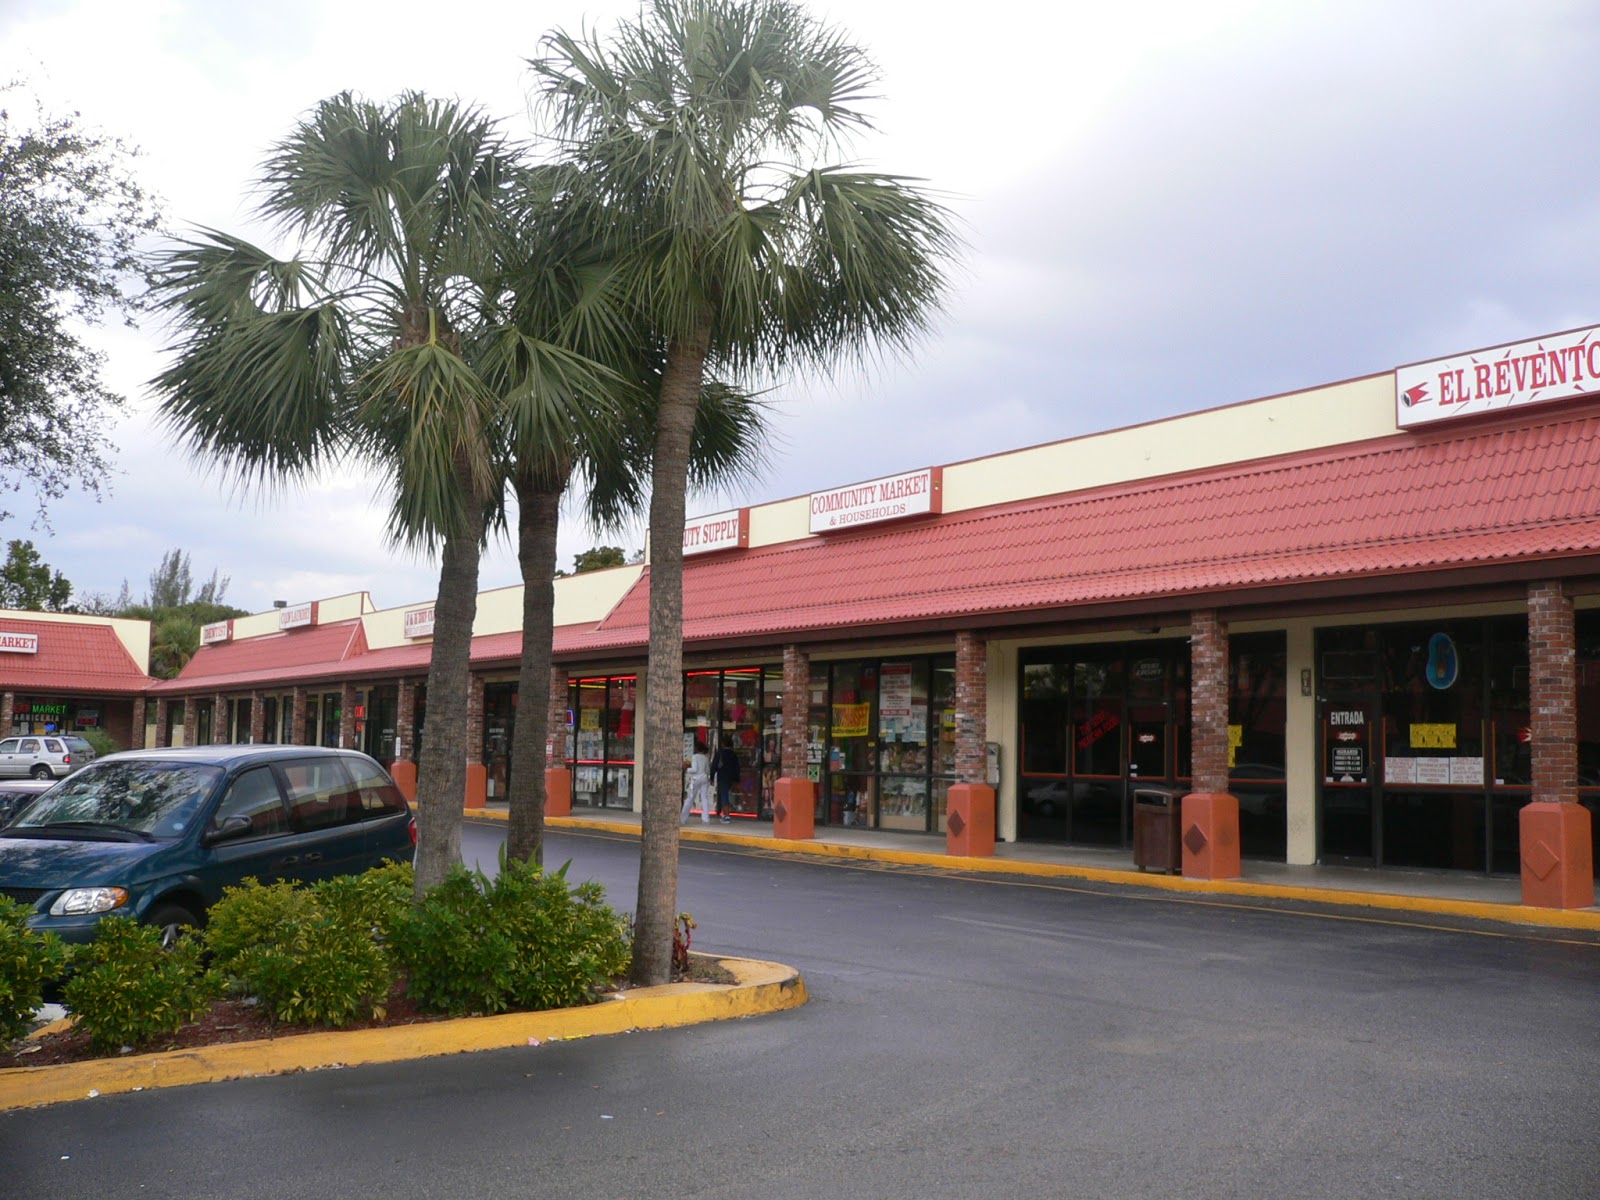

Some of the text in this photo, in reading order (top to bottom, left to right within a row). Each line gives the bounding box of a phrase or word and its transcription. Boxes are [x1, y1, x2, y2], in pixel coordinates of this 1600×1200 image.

[1438, 368, 1470, 406] EL
[811, 474, 928, 515] COMMUNITY MARKET
[829, 502, 906, 526] & HOUSEHOLDS
[703, 518, 738, 544] SUPPLY
[0, 636, 36, 649] ARKET
[32, 704, 66, 714] MARKET
[1330, 710, 1365, 726] ENTRADA
